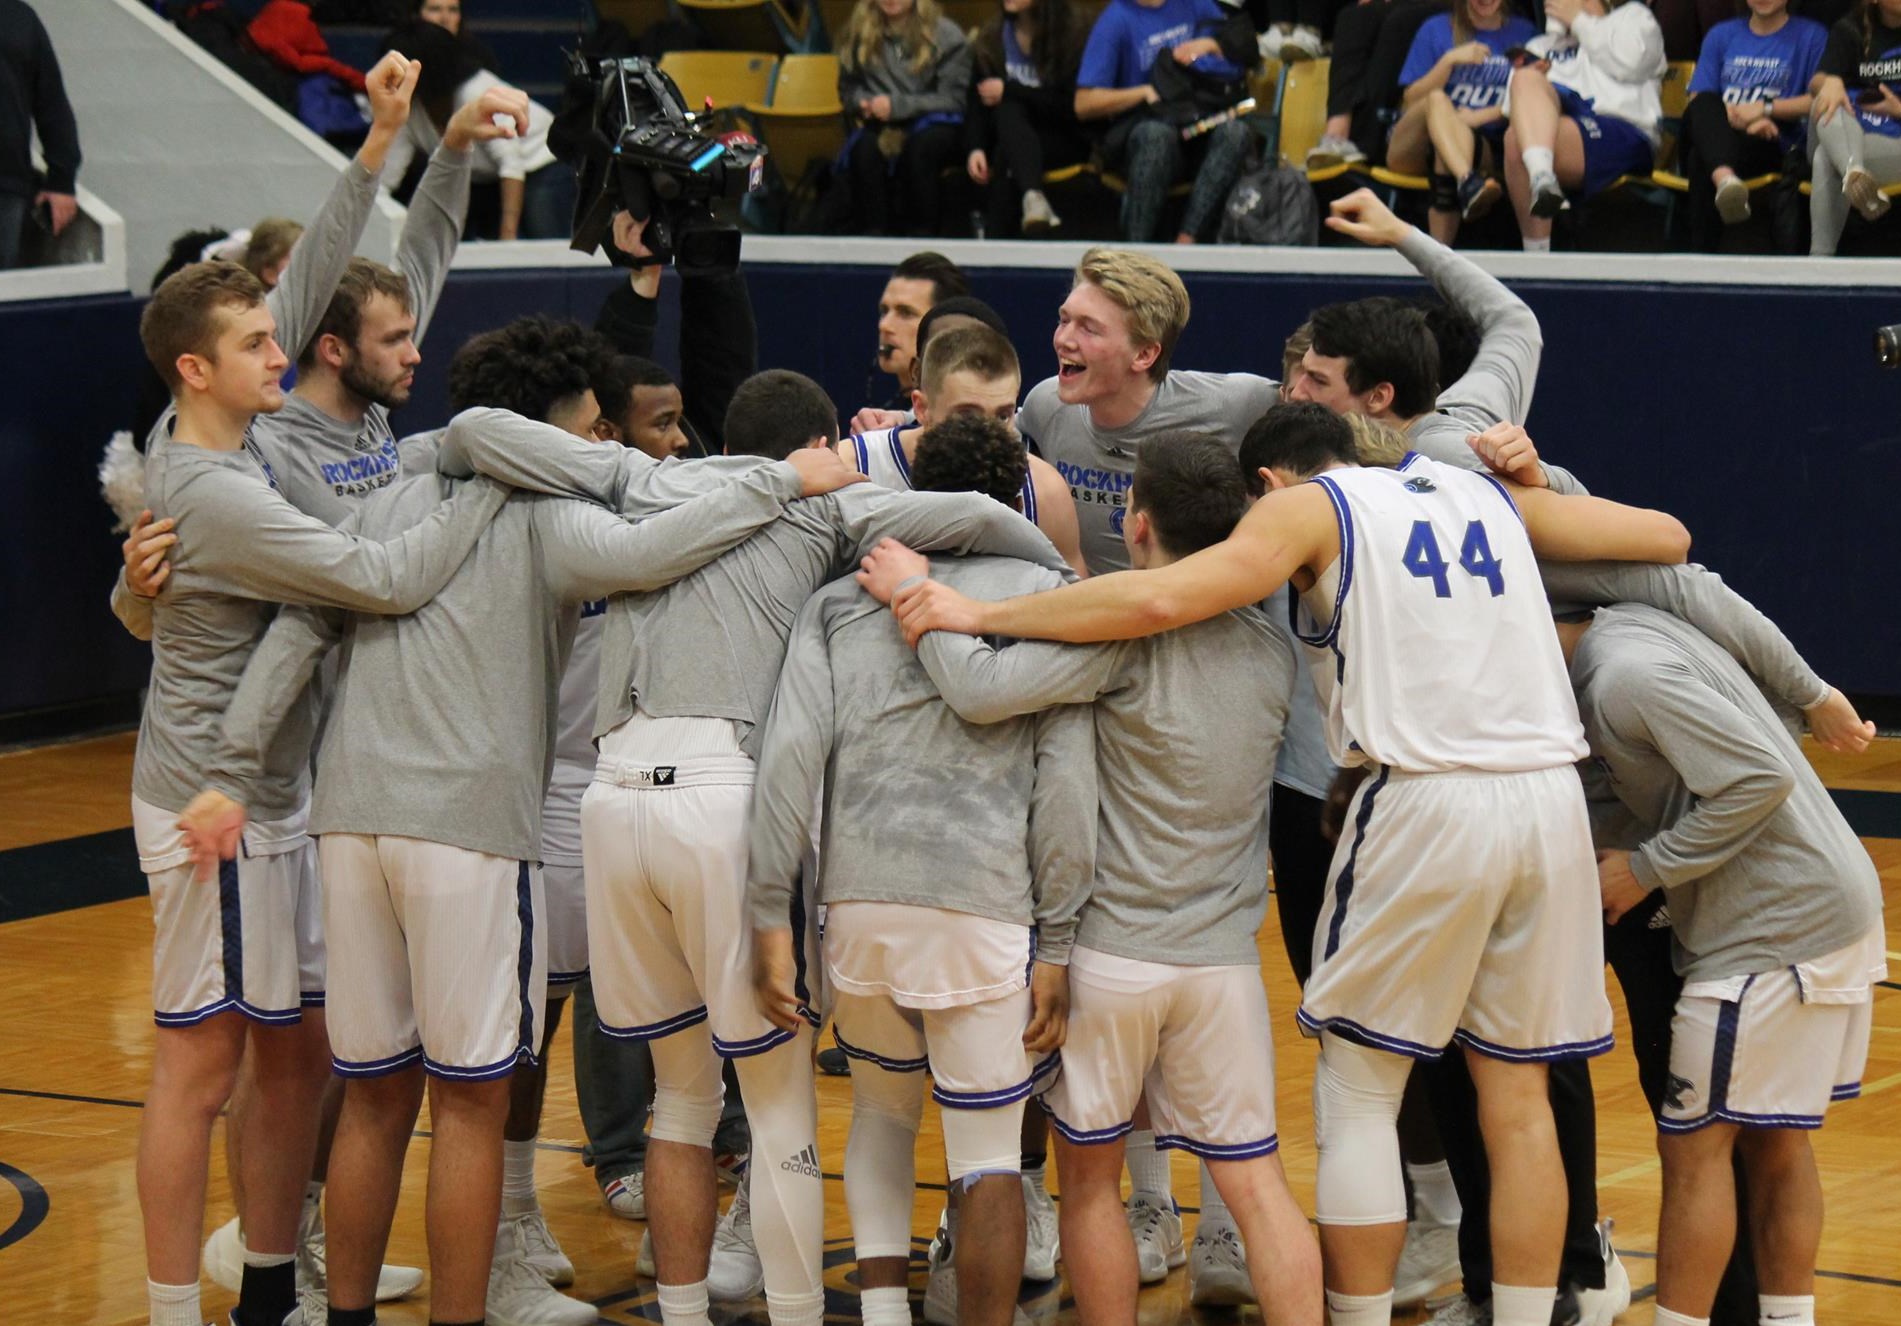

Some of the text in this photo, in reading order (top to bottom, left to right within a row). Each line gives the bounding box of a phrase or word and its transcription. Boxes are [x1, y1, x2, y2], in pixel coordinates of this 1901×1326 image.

[1859, 59, 1901, 77] ROCKH
[1070, 487, 1122, 506] ASKE
[1402, 519, 1505, 598] 44
